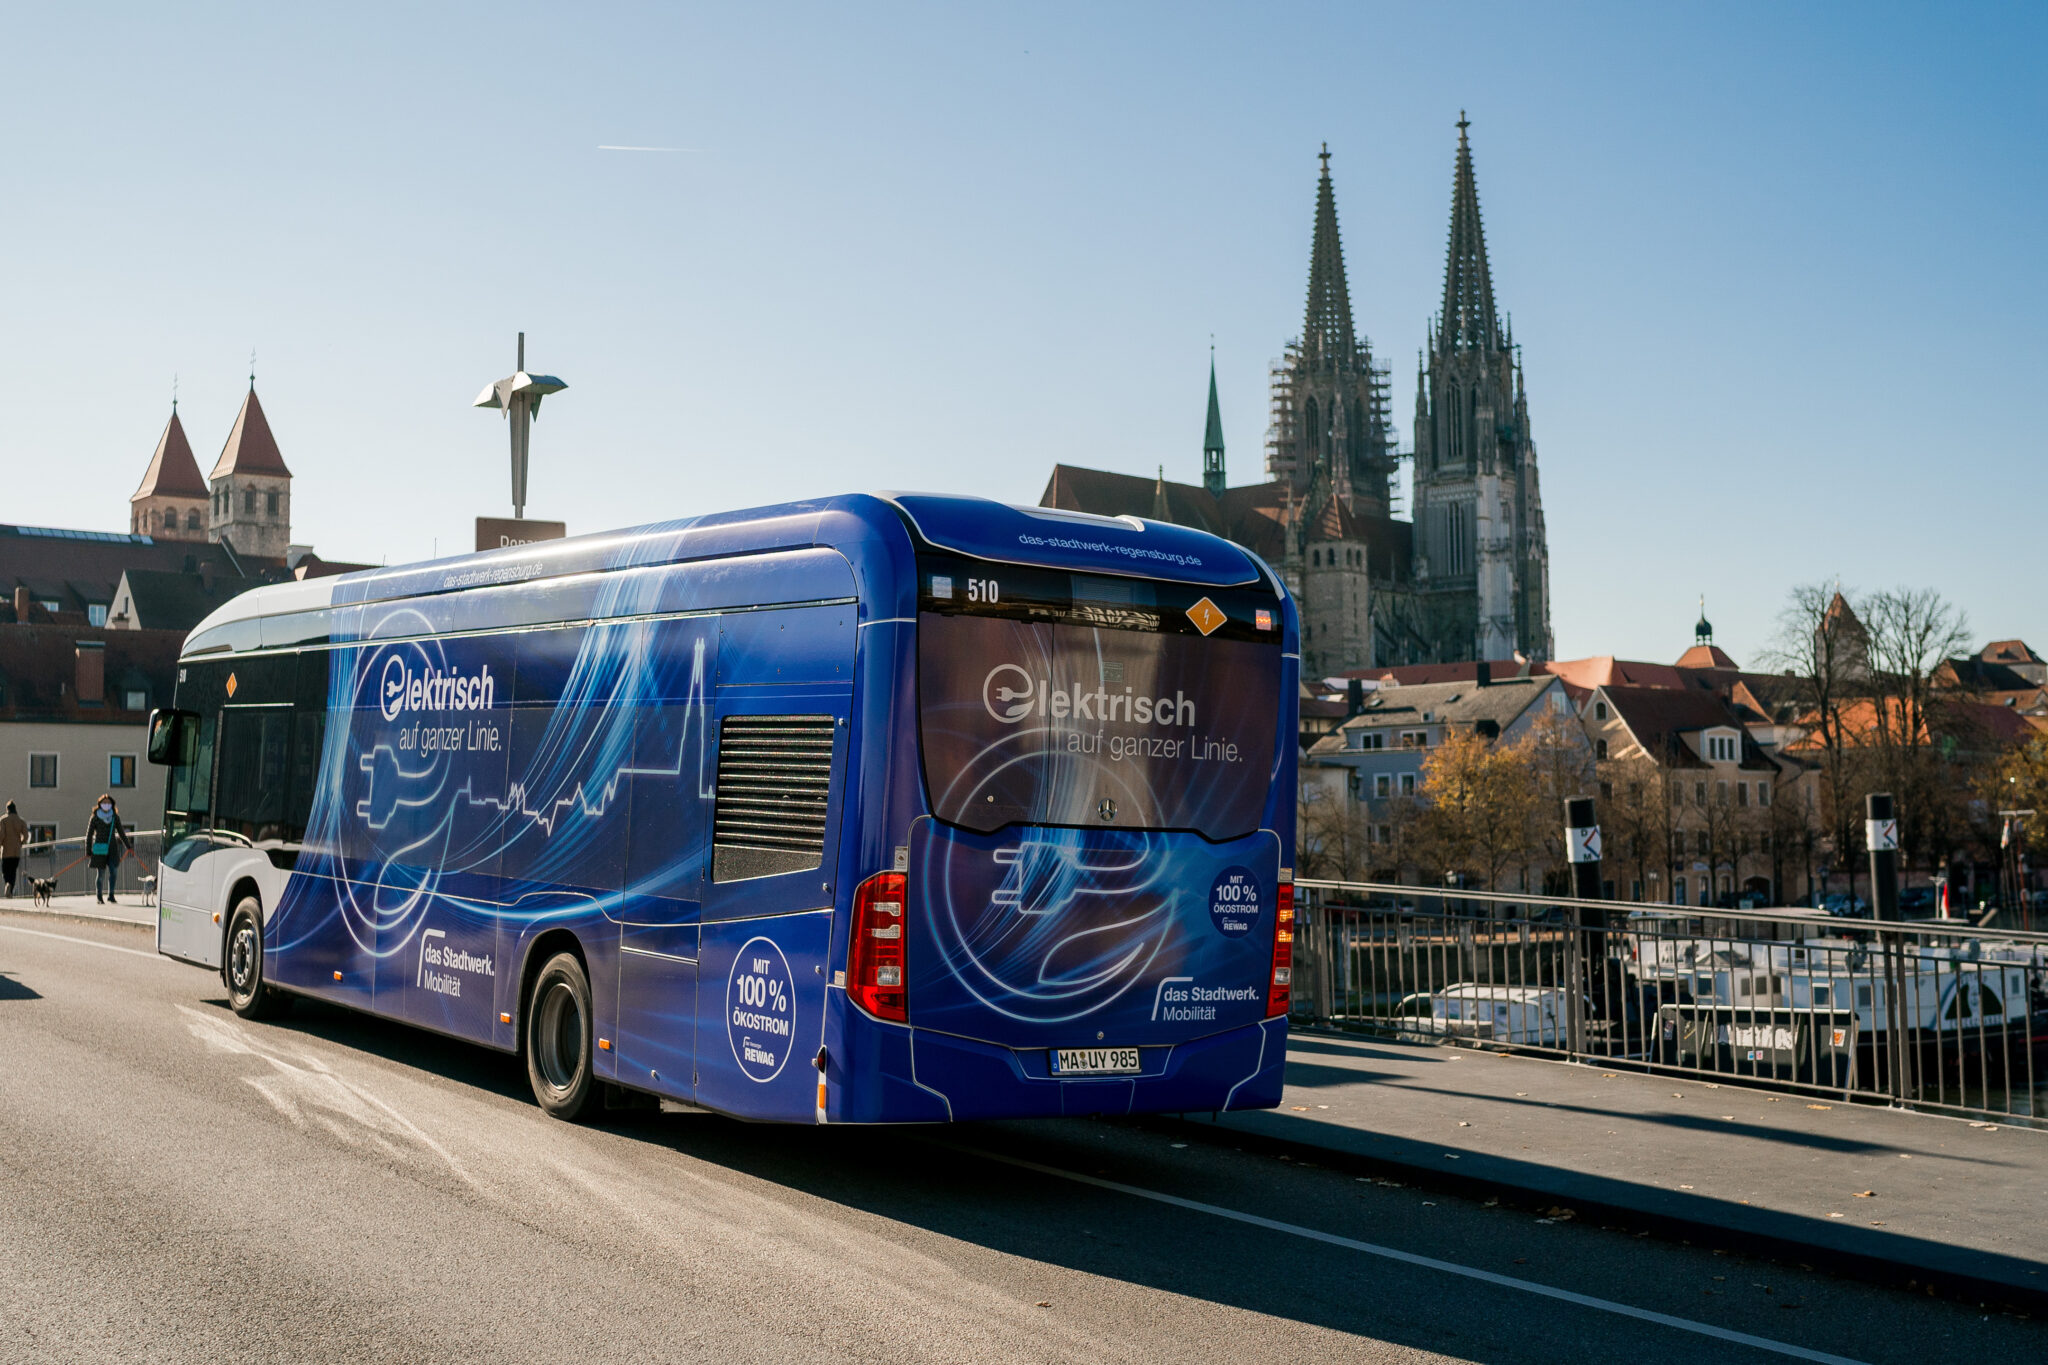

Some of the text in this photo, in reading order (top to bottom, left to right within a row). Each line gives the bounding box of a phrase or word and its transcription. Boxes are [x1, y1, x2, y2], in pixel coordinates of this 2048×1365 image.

[500, 535, 536, 548] Don
[1018, 534, 1202, 565] das-stadtwerk-regensburg.de
[443, 561, 543, 588] das-stadtwerk-regensburg.de
[968, 578, 998, 603] 510
[399, 720, 502, 757] auf ganzer Linie.
[1067, 730, 1243, 762] auf ganzer Linie.
[1229, 875, 1244, 884] MIT
[1216, 884, 1257, 902] 100 %
[1213, 902, 1258, 914] ÖKOSTROM
[425, 943, 495, 976] das Stadtwerk.
[753, 958, 771, 975] MIT
[424, 970, 461, 998] Mobilität
[737, 974, 787, 1012] 100 %
[1164, 986, 1260, 1001] das Stadtwerk.
[733, 1006, 789, 1036] ÖKOSTROM
[1163, 1006, 1217, 1021] Mobilität
[744, 1047, 775, 1067] REWAG
[1059, 1052, 1080, 1069] MA
[1088, 1051, 1107, 1068] UY
[1110, 1051, 1137, 1068] 985
